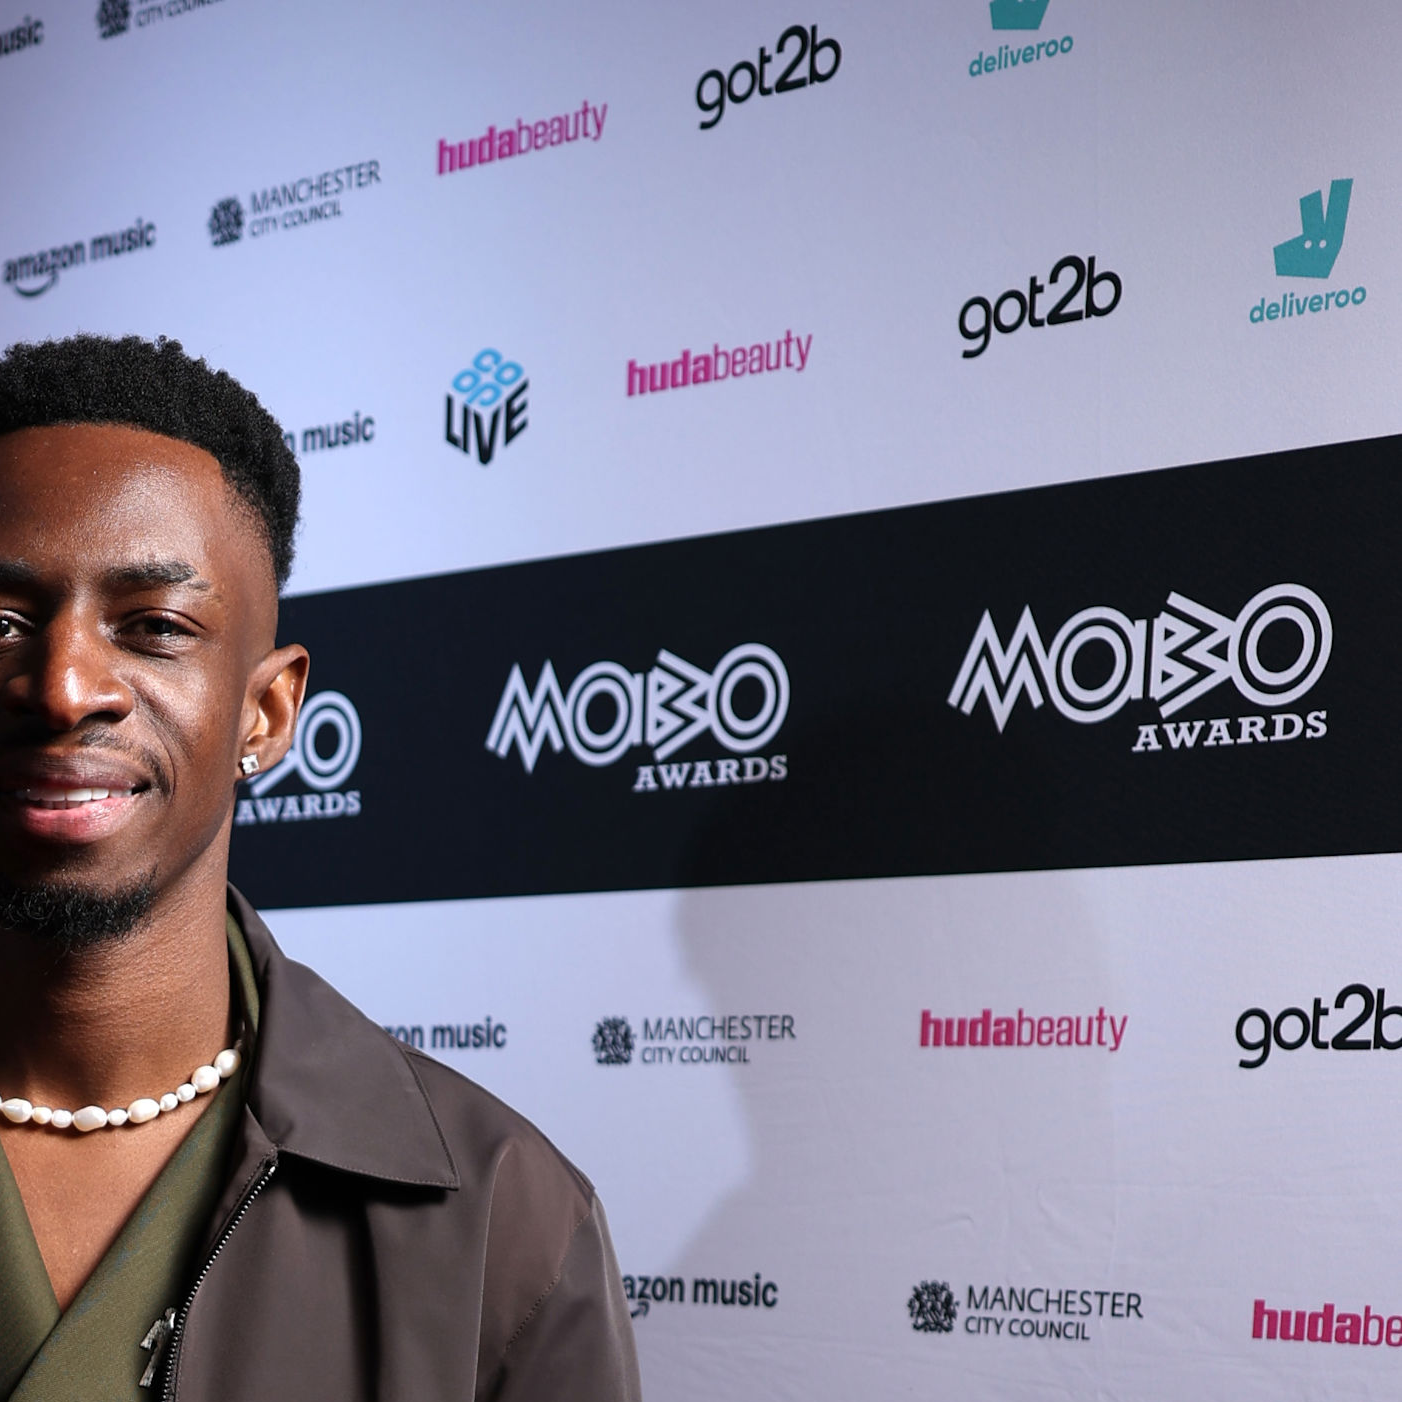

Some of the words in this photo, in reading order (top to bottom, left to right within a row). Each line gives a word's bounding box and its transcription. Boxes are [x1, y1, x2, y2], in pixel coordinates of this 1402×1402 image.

[695, 24, 842, 131] got2b
[968, 33, 1075, 78] deliveroo
[438, 99, 609, 176] hudabeauty
[250, 160, 382, 214] MANCHESTER
[249, 216, 279, 238] CITY
[281, 200, 343, 230] COUNCIL
[3, 241, 85, 283] amazon
[87, 217, 157, 262] music
[958, 254, 1124, 358] got2b
[1249, 283, 1368, 325] deliveroo
[626, 330, 814, 399] hudabeauty
[302, 411, 375, 453] music
[445, 384, 529, 466] LIVE
[947, 582, 1334, 735] MOBO
[485, 642, 791, 773] MOBO
[1132, 709, 1329, 753] AWARDS
[632, 754, 789, 791] AWARDS
[234, 790, 362, 826] AWARDS
[431, 1014, 507, 1050] music
[642, 1015, 796, 1041] MANCHESTER
[920, 1007, 1127, 1052] hudabeauty
[1235, 983, 1402, 1069] got2b
[641, 1045, 674, 1064] CITY
[679, 1045, 750, 1064] COUNCIL
[622, 1274, 686, 1304] azon
[693, 1271, 779, 1309] music
[966, 1284, 1144, 1319] MANCHESTER
[964, 1315, 1003, 1336] CITY
[1007, 1317, 1091, 1342] COUNCIL
